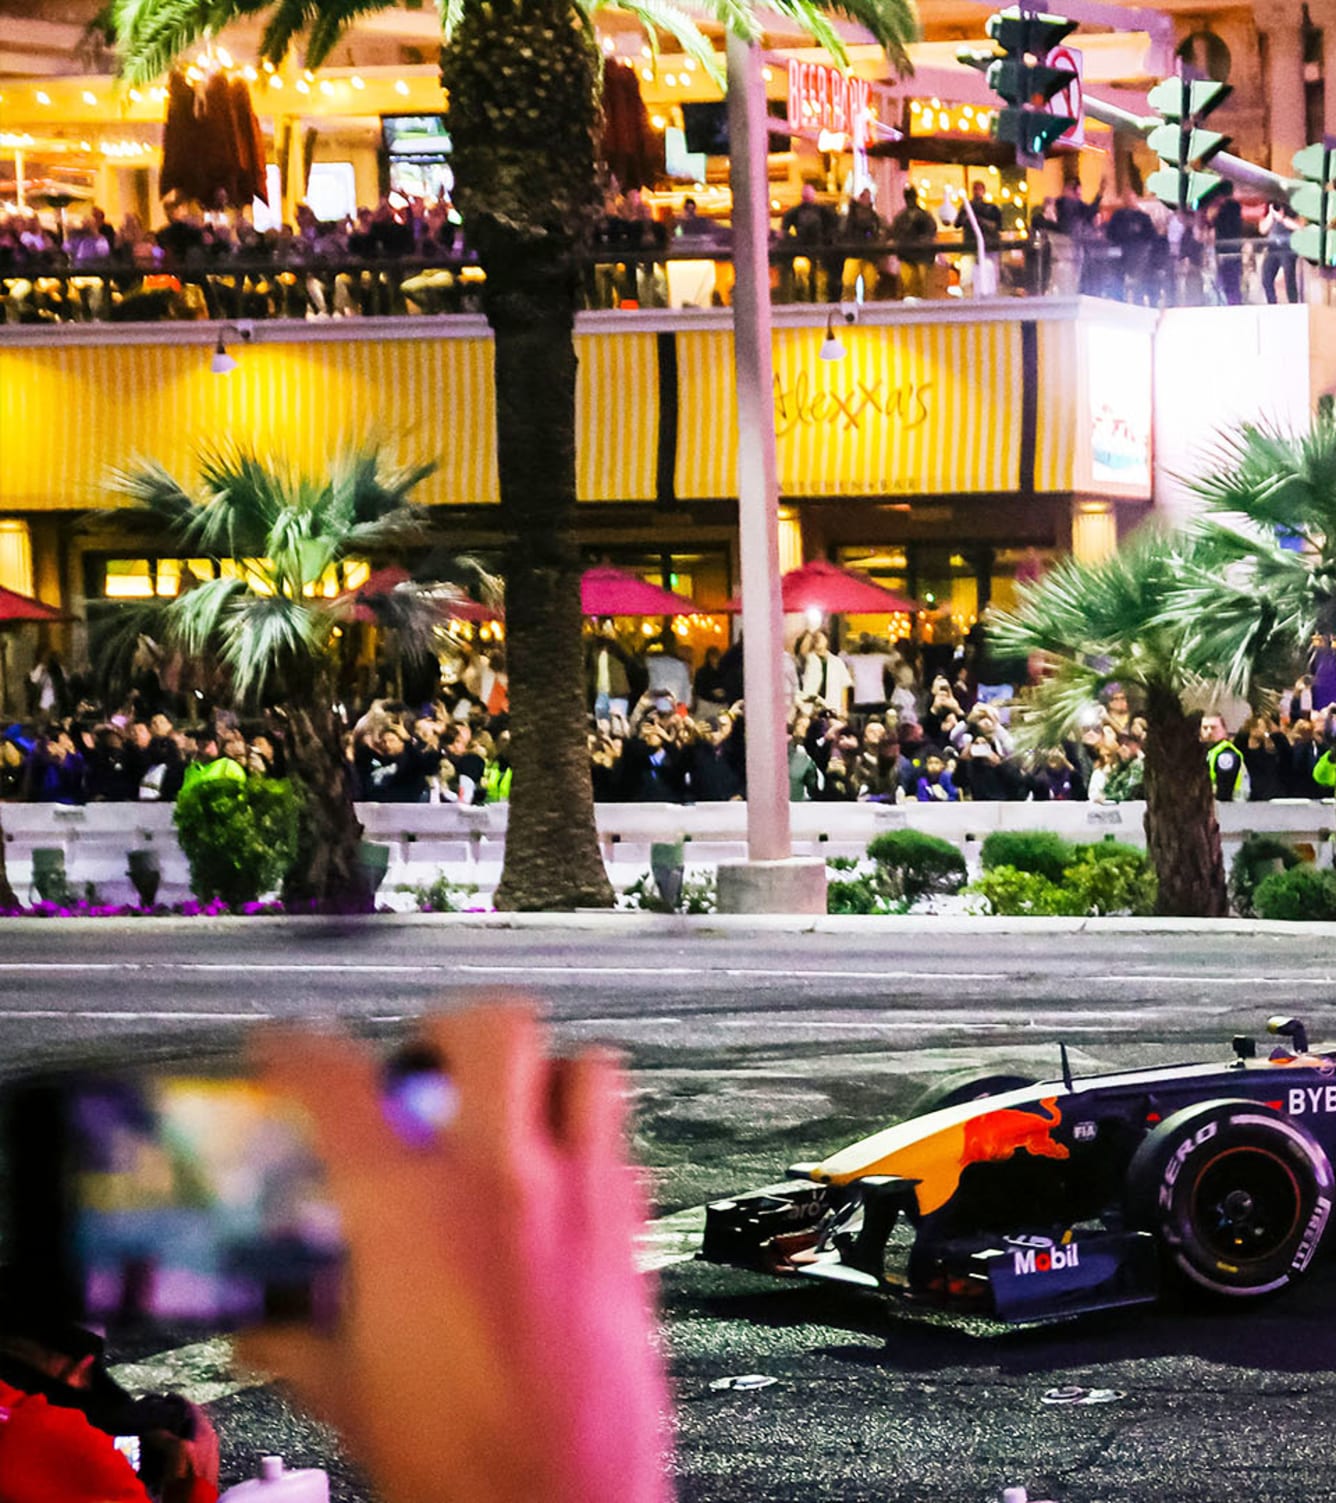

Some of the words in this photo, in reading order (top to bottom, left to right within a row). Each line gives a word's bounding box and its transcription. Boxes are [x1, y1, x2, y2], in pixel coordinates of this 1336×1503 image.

[788, 59, 829, 130] BEER
[1073, 1125, 1097, 1139] FIA
[1159, 1121, 1219, 1211] ZERO
[1014, 1243, 1079, 1275] Mobil
